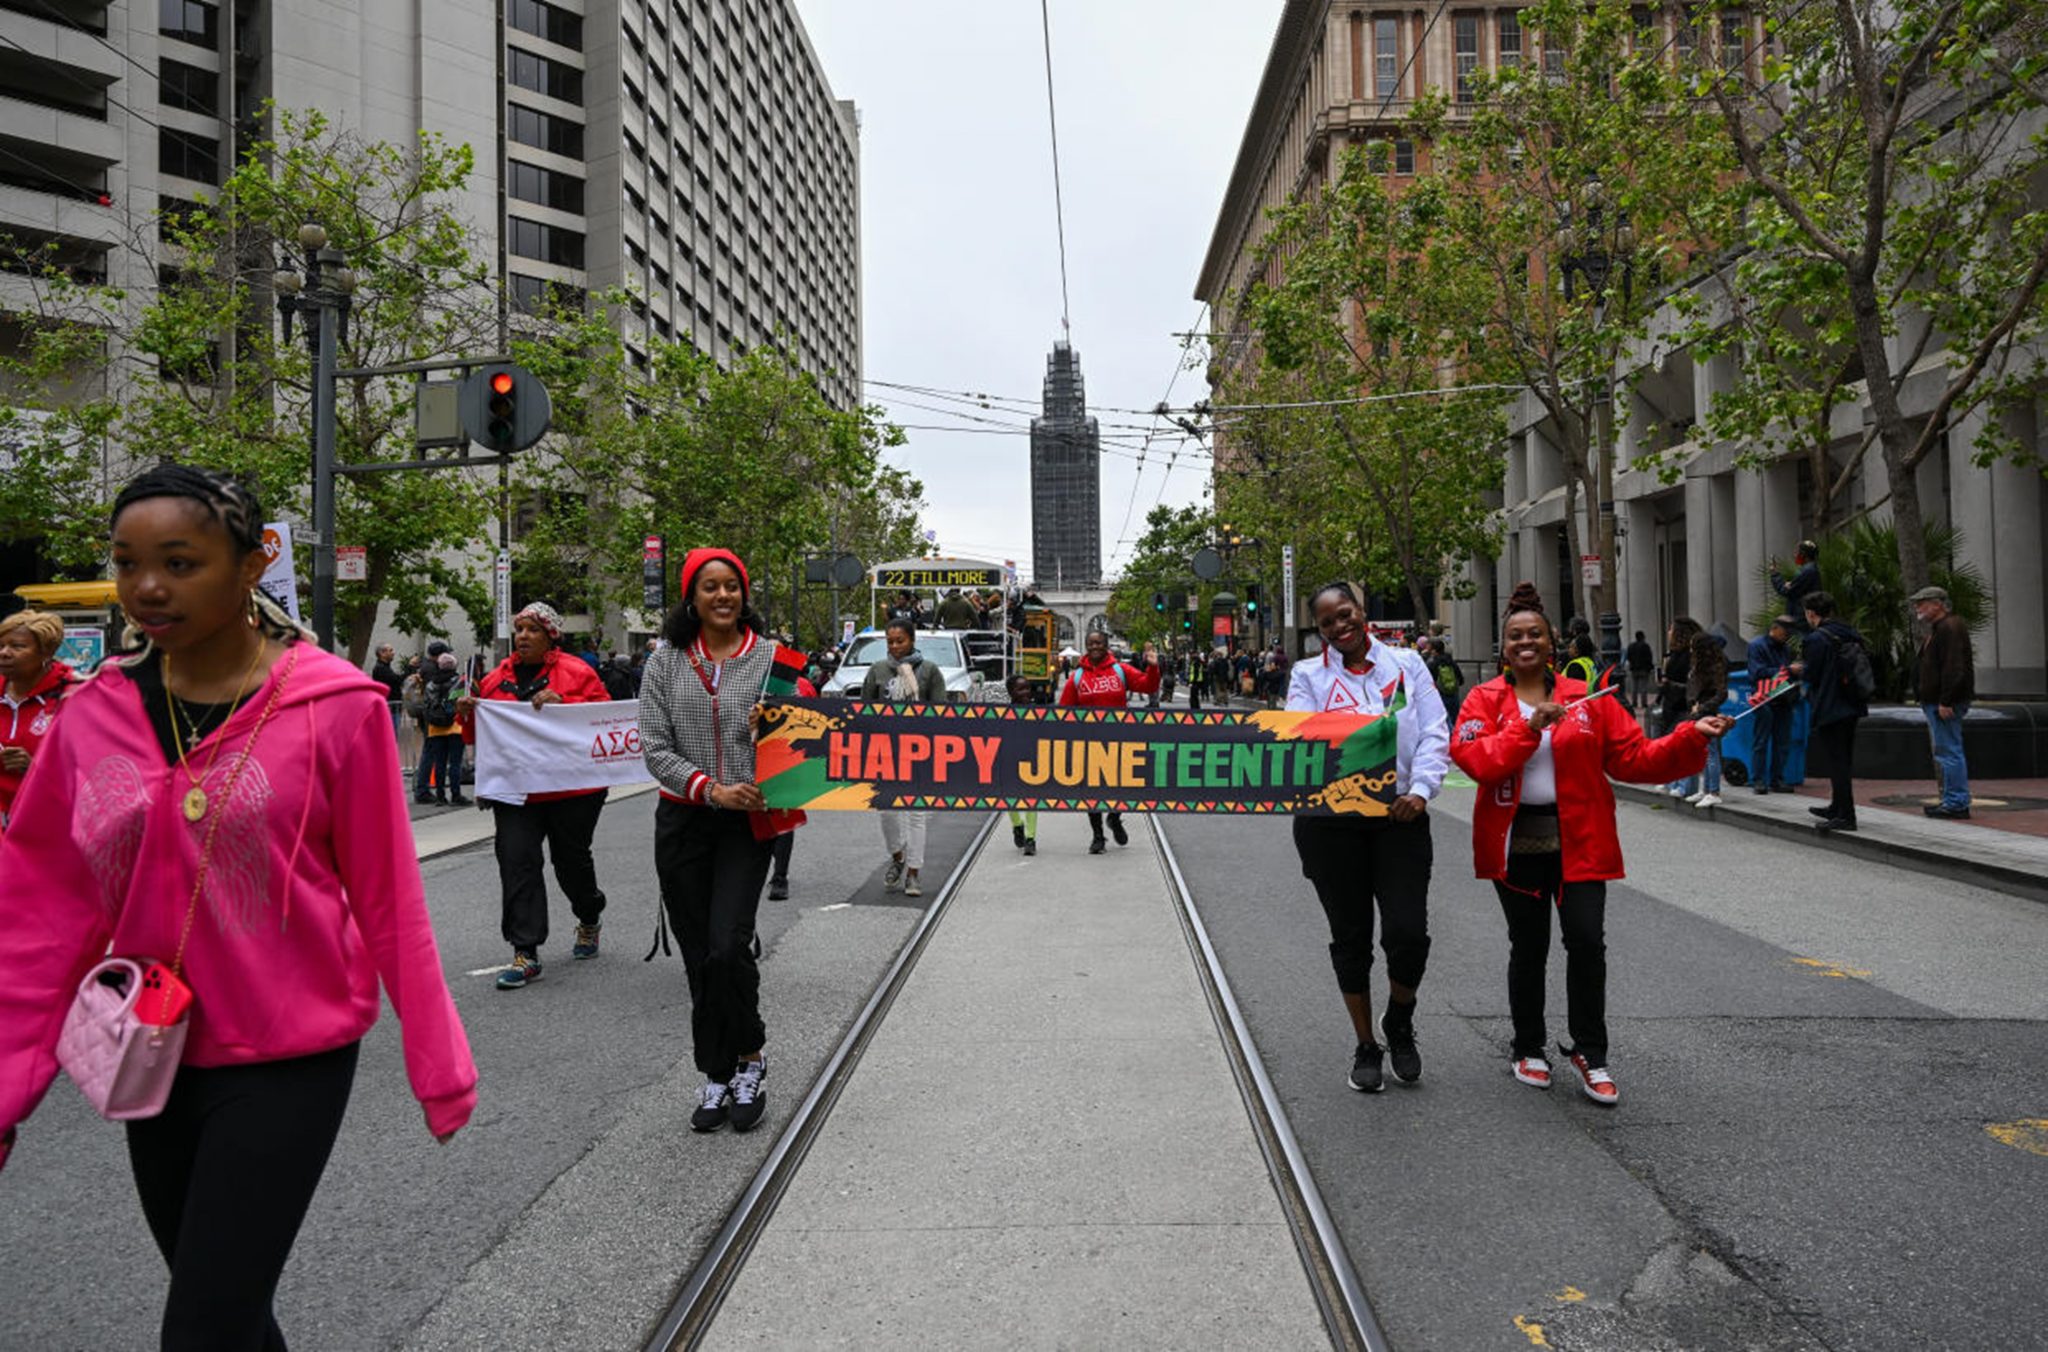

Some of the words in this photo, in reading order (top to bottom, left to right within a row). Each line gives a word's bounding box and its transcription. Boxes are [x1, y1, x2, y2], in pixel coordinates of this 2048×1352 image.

[885, 570, 905, 586] 22
[909, 570, 989, 585] FILLMORE
[828, 731, 1002, 784] HAPPY
[1018, 738, 1327, 787] JUNETEENTH
